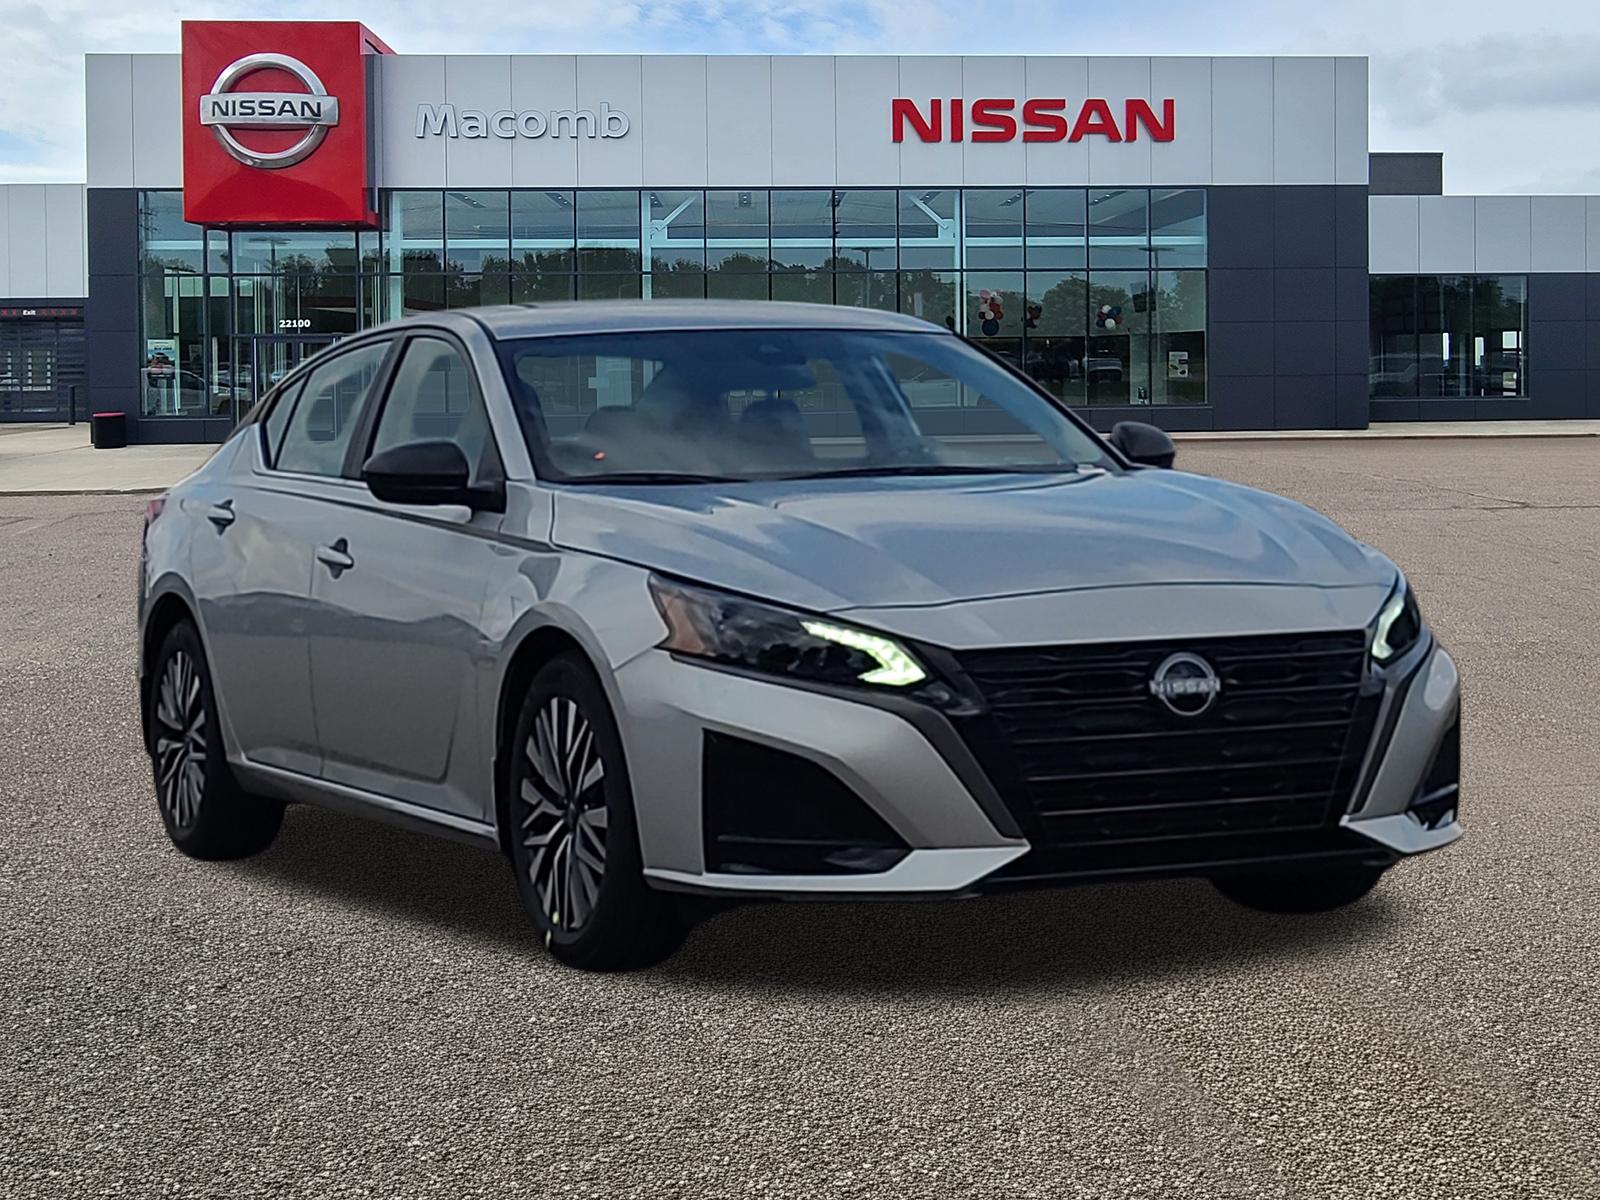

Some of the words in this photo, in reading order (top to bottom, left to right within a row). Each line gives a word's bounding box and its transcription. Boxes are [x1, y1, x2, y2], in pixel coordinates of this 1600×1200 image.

[212, 100, 321, 117] NISSAN
[415, 102, 630, 138] Macomb
[892, 98, 1175, 142] NISSAN
[279, 319, 311, 328] 22100
